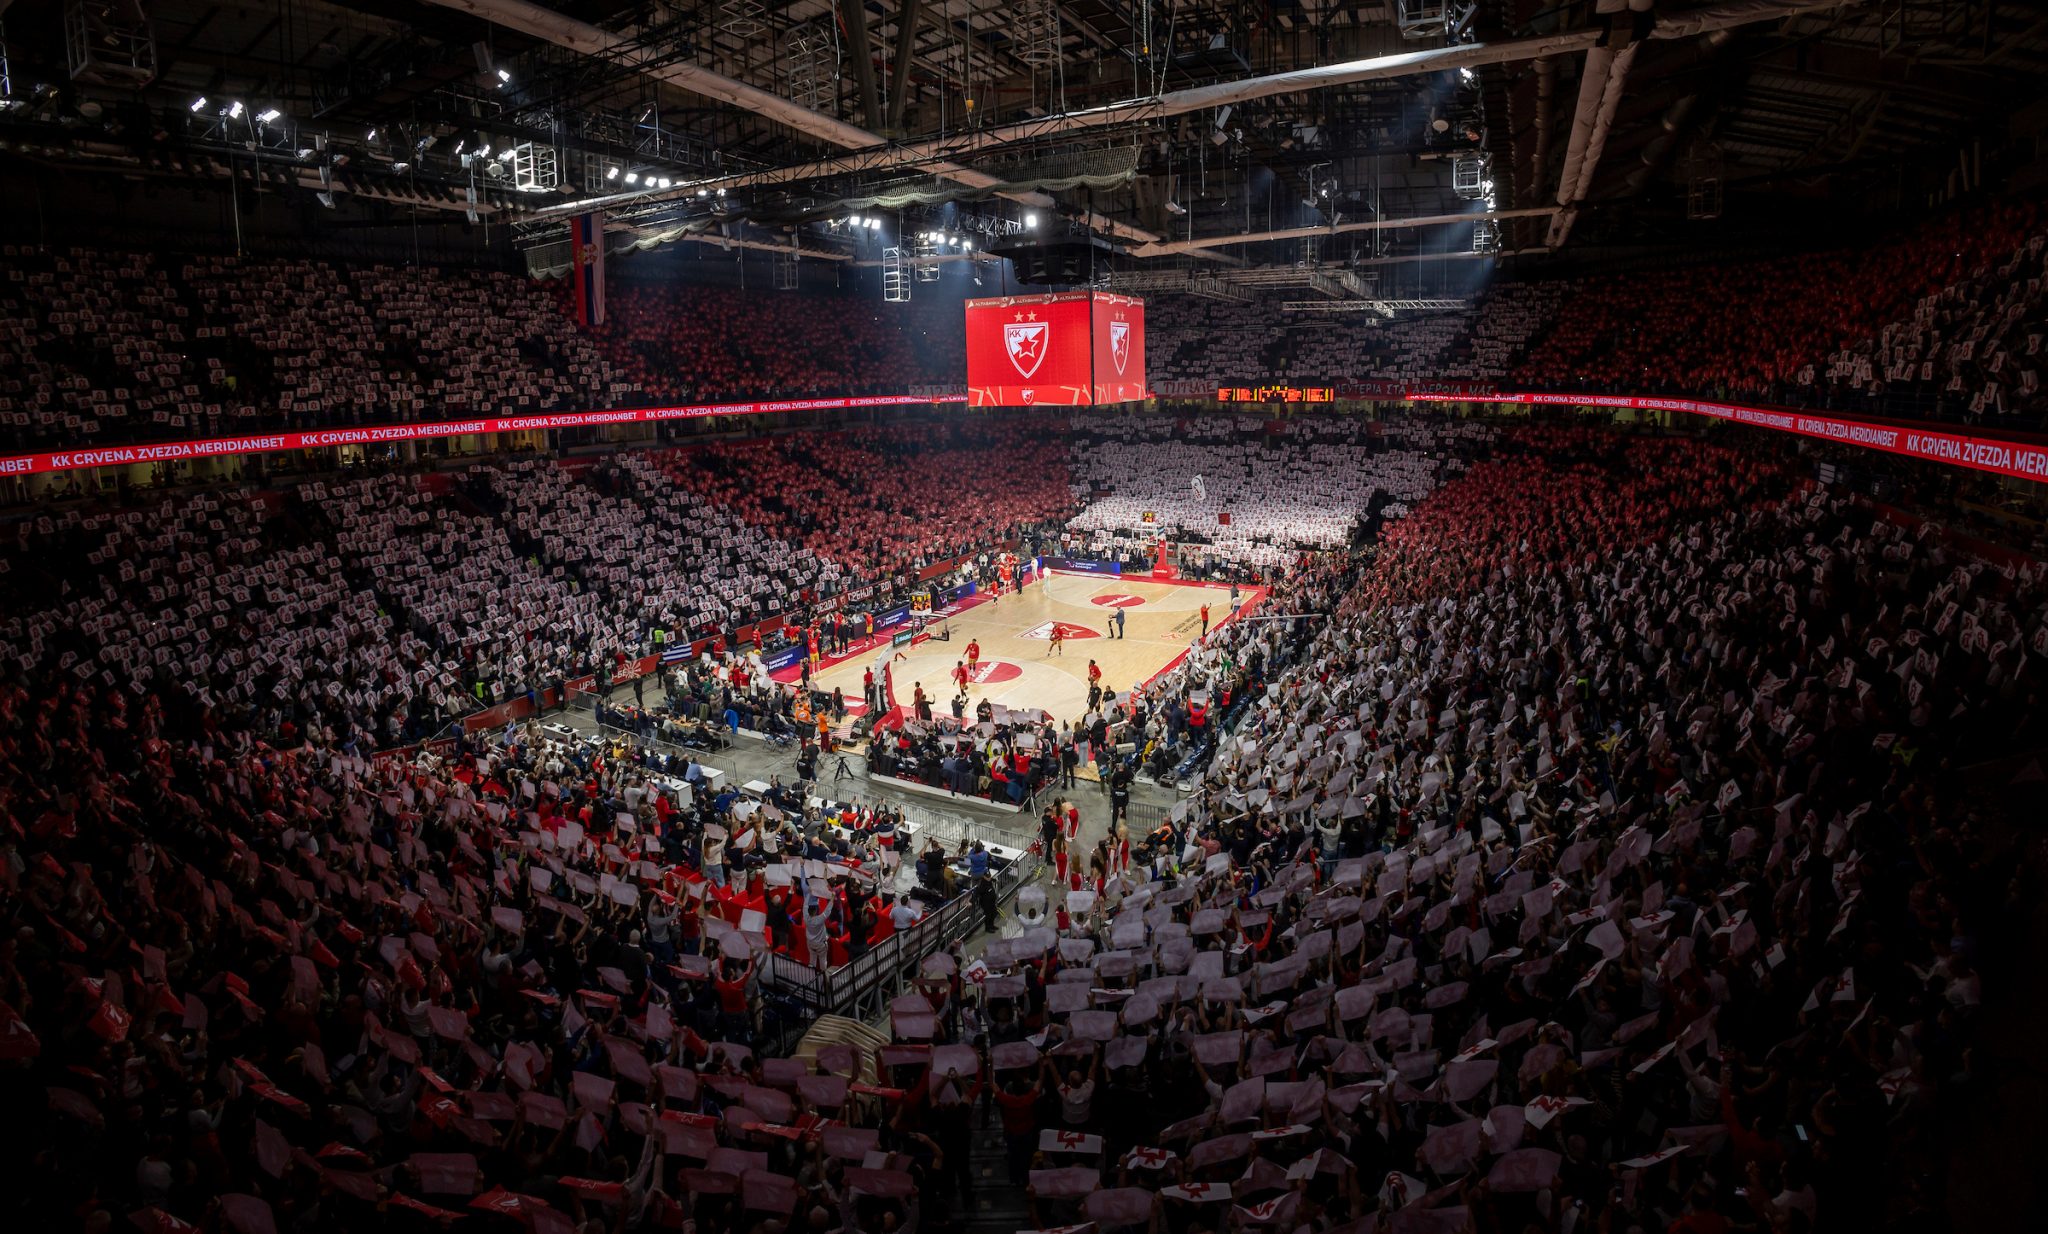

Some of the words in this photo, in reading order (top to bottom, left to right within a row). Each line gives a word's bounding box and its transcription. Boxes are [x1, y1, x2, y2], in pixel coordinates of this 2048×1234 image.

[1009, 329, 1022, 338] KK
[769, 403, 791, 411] CRVENA
[792, 401, 812, 409] ZVEZDA
[1569, 396, 1594, 404] ZVEZDA
[646, 411, 656, 419] KK
[657, 409, 685, 418] CRVENA
[686, 407, 712, 416] ZVEZDA
[713, 404, 754, 414] MERIDIANBET
[497, 420, 511, 430] KK
[513, 418, 549, 429] CRVENA
[550, 415, 585, 426] ZVEZDA
[585, 412, 637, 423] MERIDIANBET
[301, 434, 318, 445] KK
[321, 428, 368, 444] CRVENA
[371, 427, 415, 440] ZVEZDA
[417, 422, 486, 436] MERIDIANBET
[1798, 418, 1804, 429] KK
[1804, 420, 1825, 434] CRVENA
[1825, 422, 1849, 438] ZVEZDA
[1849, 425, 1898, 447] MERIDIANBET
[52, 454, 71, 467] KK
[73, 449, 133, 465] CRVENA
[137, 445, 192, 459] ZVEZDA
[194, 437, 285, 454] MERIDIANBET
[1907, 434, 1919, 452] KK
[1920, 436, 1961, 460] CRVENA
[1963, 442, 2011, 470] ZVEZDA
